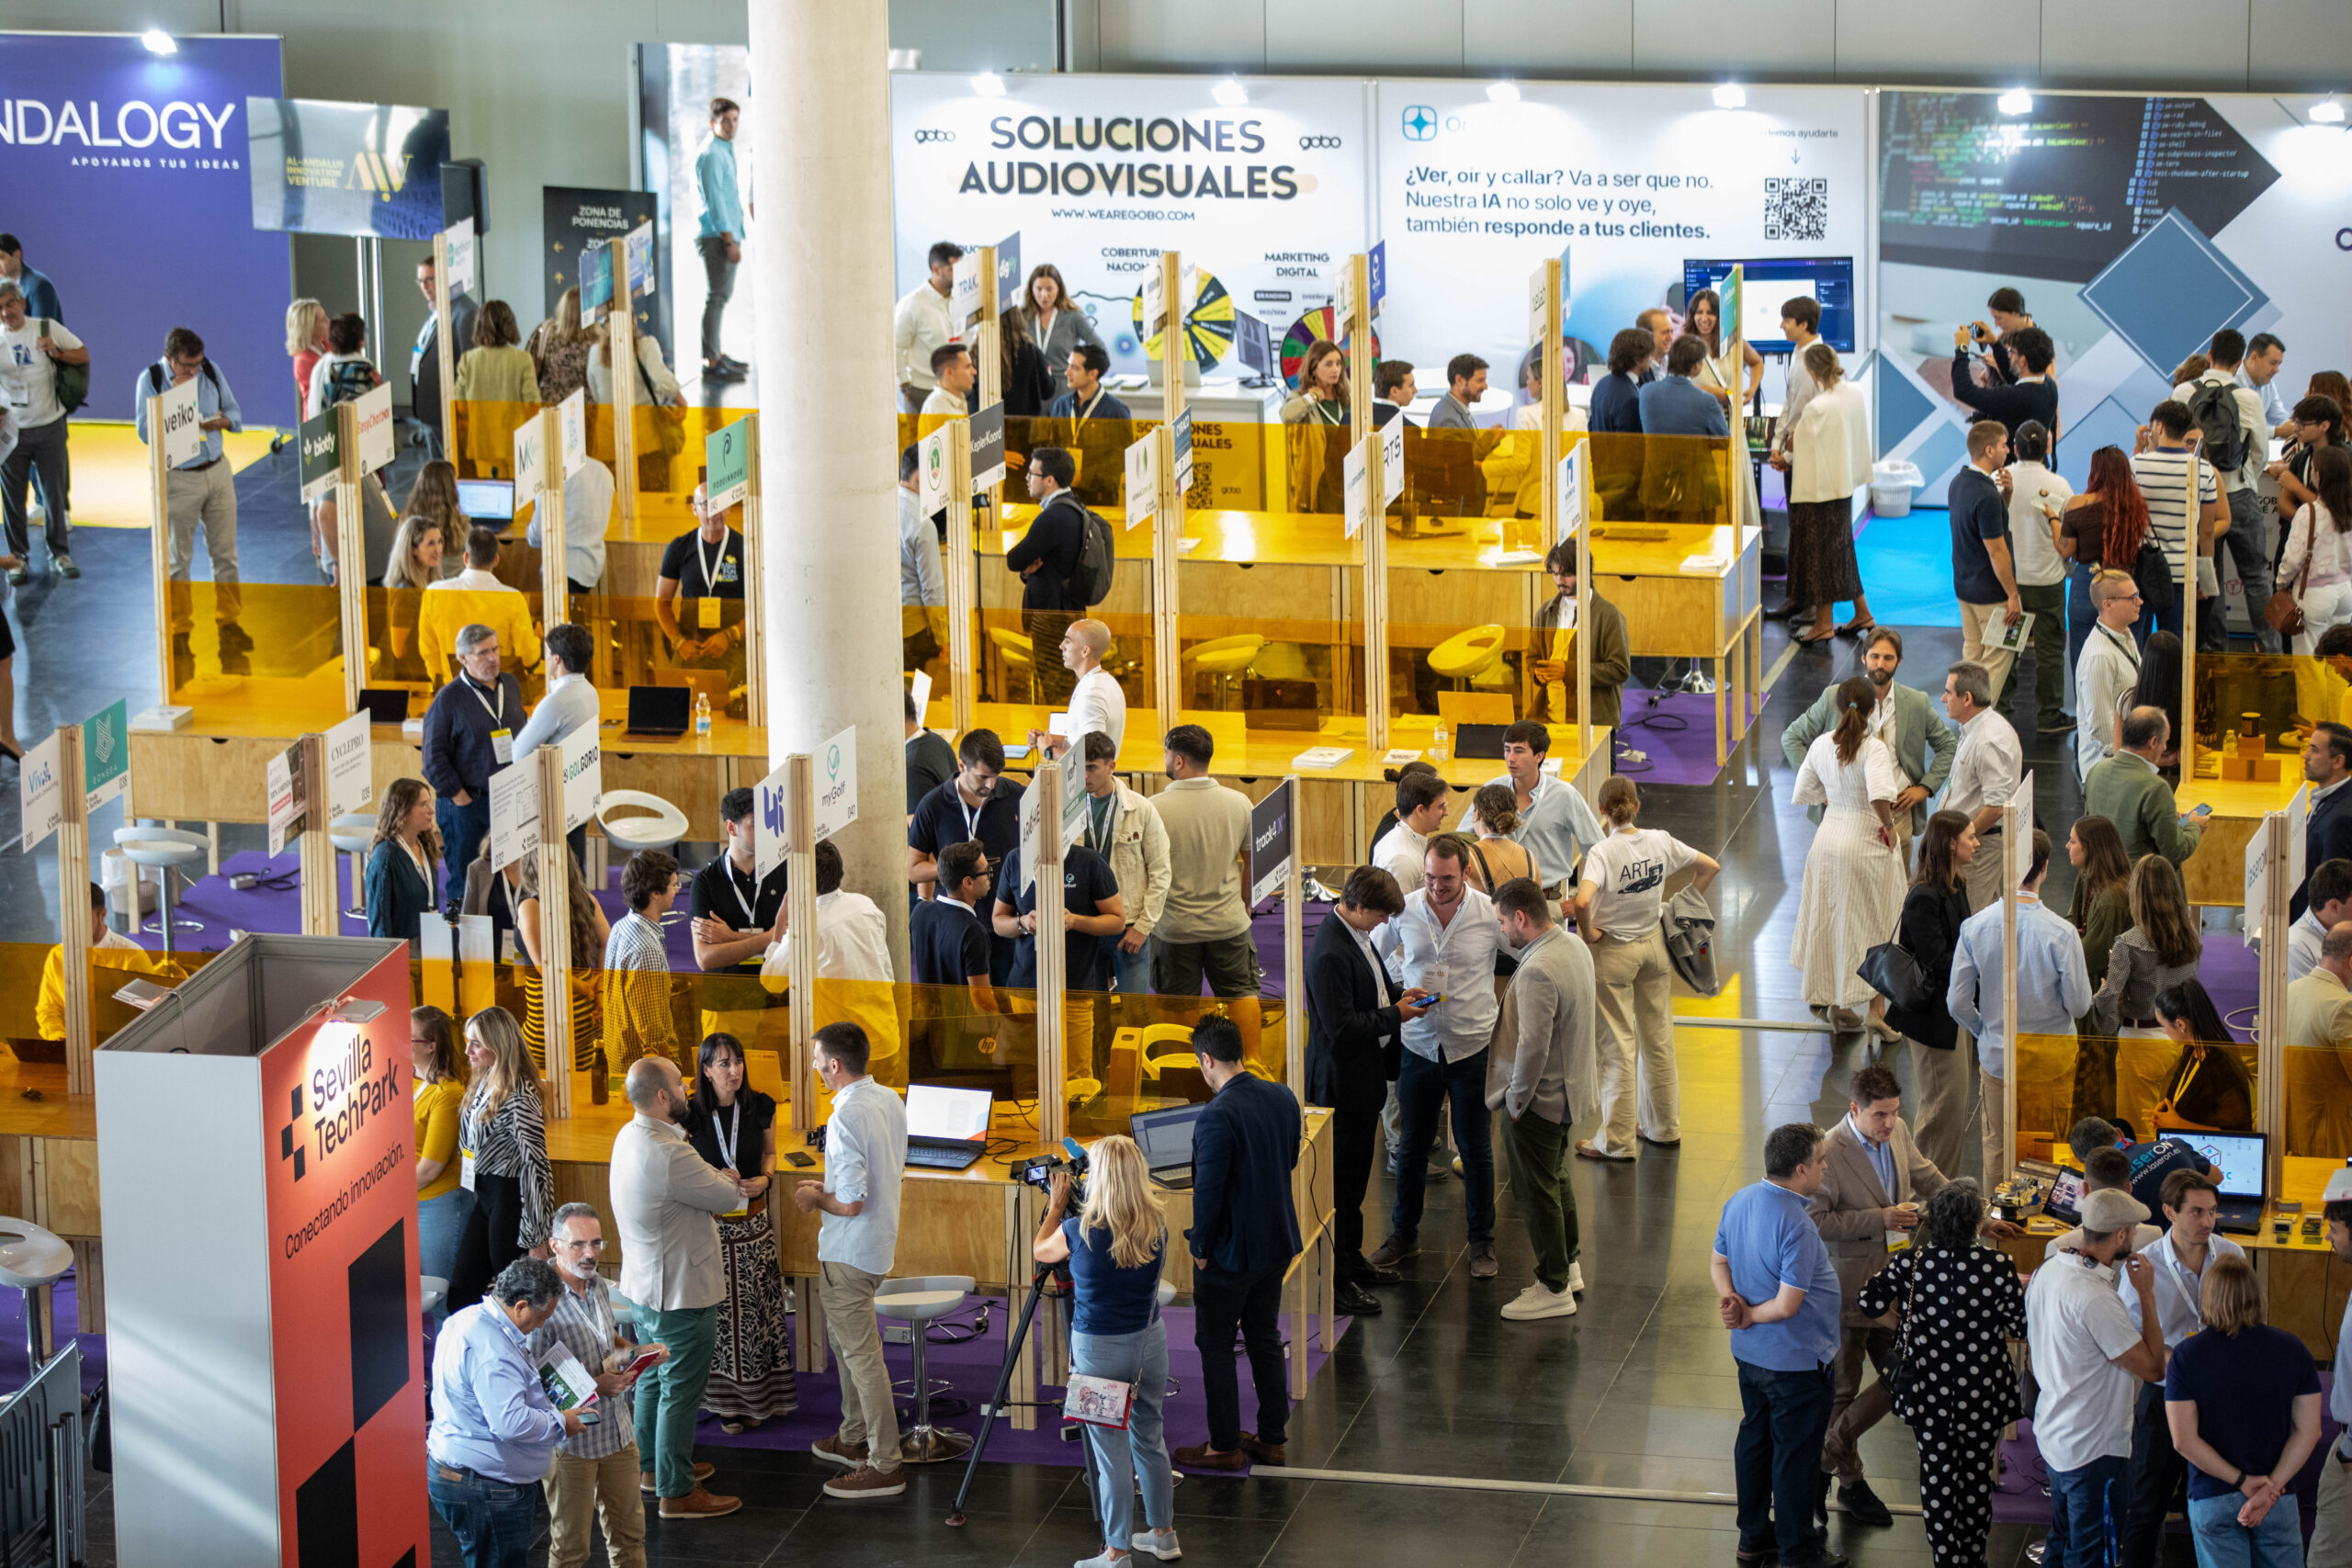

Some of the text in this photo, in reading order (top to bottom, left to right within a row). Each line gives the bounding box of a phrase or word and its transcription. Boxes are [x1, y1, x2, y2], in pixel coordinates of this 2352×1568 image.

[914, 128, 956, 143] gobo
[989, 115, 1265, 153] SOLUCIONES
[1299, 134, 1342, 151] gobo
[1798, 129, 1838, 140] ayudarte
[71, 156, 240, 171] APOYAMOS TUS IDEAS
[286, 167, 342, 178] INNOVATION
[287, 175, 338, 188] VENTURE
[958, 160, 1299, 201] AUDIOVISUALES
[1406, 165, 1452, 186] ¿Ver,
[1487, 172, 1497, 187] y
[1501, 169, 1564, 186] callar?
[1569, 170, 1592, 186] Va
[1597, 174, 1608, 187] a
[1612, 174, 1642, 187] ser
[1645, 174, 1681, 192] que
[1686, 175, 1713, 189] no.
[579, 205, 622, 219] ZONA DE
[1050, 209, 1195, 221] WWW.WEAREGOBO.COM
[1406, 190, 1657, 216] Nuestra IA no solo ve y oye,
[571, 216, 629, 230] PONENCIAS
[1406, 216, 1711, 239] también responde a tus clientes.
[1102, 247, 1164, 258] COBERTUR
[1264, 253, 1330, 263] MARKETING
[1276, 267, 1318, 277] DIGITAL
[164, 402, 197, 435] veiko
[970, 425, 1002, 454] KeplerKoord
[331, 733, 364, 762] CYCLEPRO
[569, 745, 599, 781] GOLGORIO
[821, 780, 846, 807] myGolf
[1620, 858, 1651, 883] ART
[312, 1032, 373, 1112] Sevilla
[313, 1057, 400, 1162] TechPark
[2131, 1147, 2182, 1186] www.laseron.es
[285, 1140, 405, 1259] Conectando innovación.
